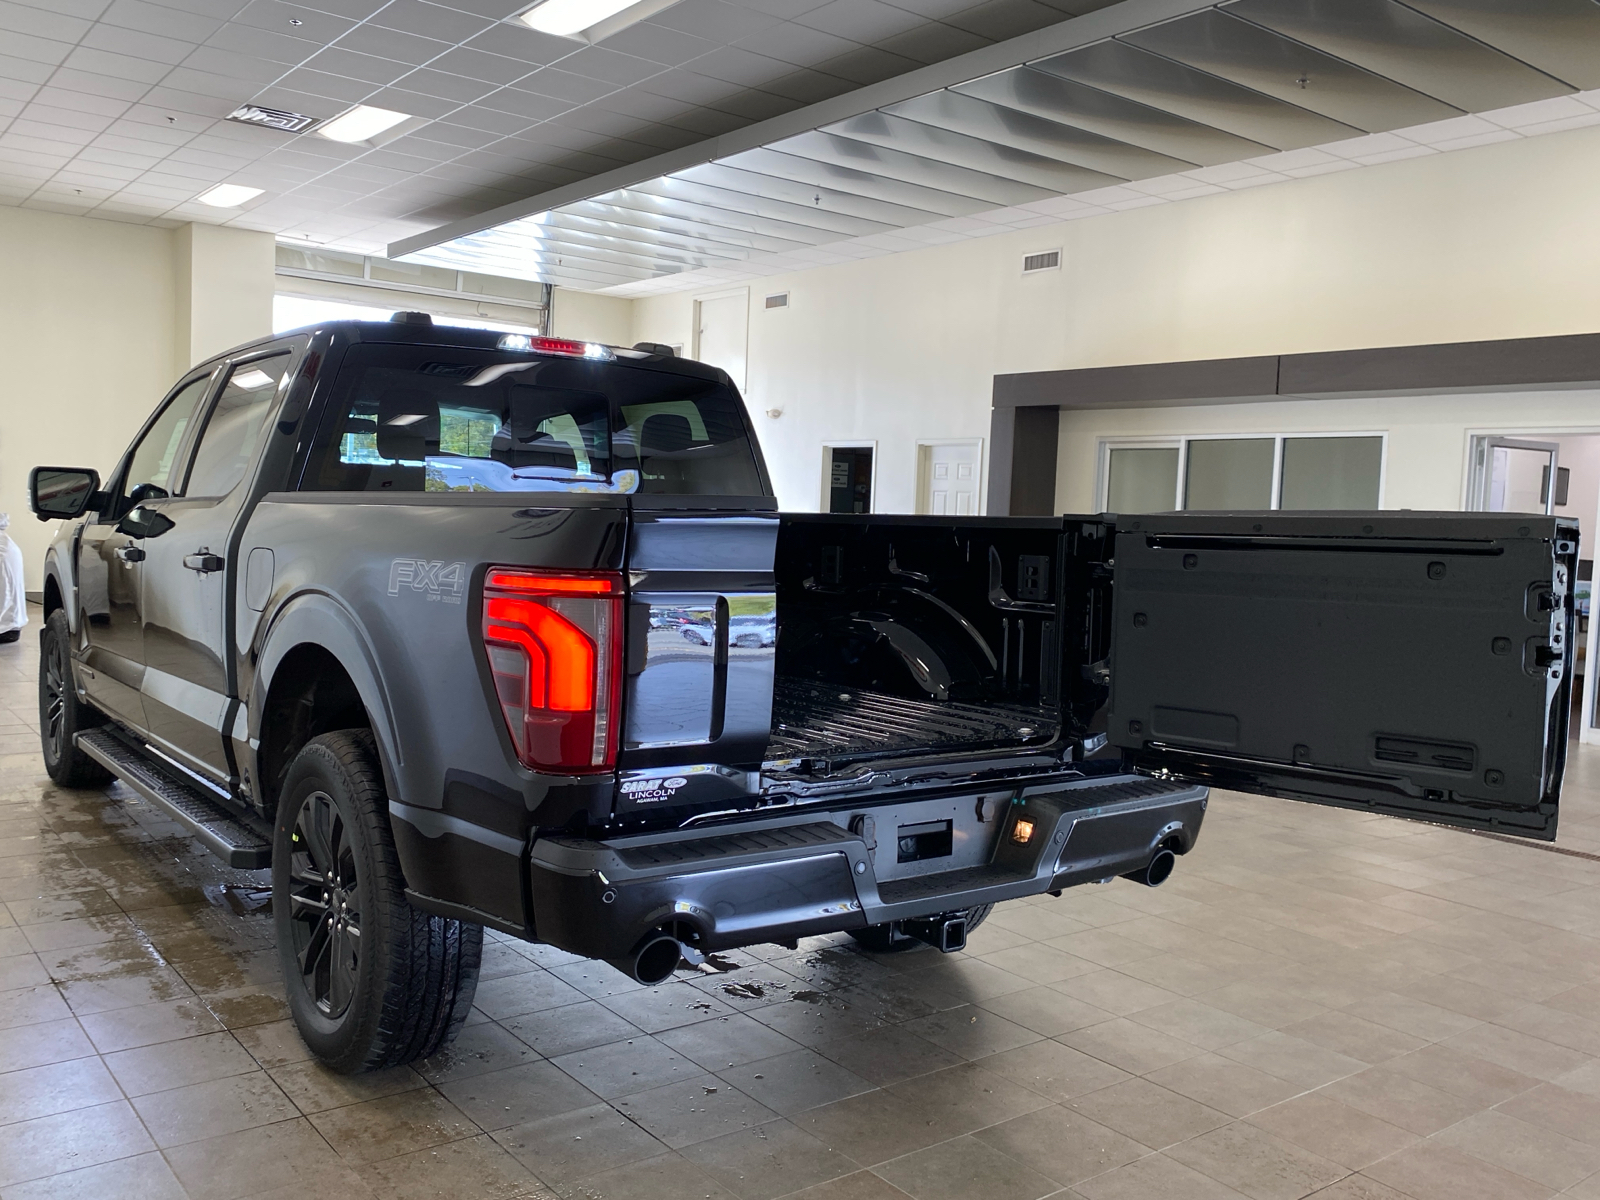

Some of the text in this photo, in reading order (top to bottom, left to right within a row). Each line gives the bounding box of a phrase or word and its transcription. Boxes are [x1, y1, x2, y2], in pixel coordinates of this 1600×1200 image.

[387, 558, 466, 596] FX4
[620, 779, 663, 793] SARAT
[629, 789, 676, 799] LINCOLN
